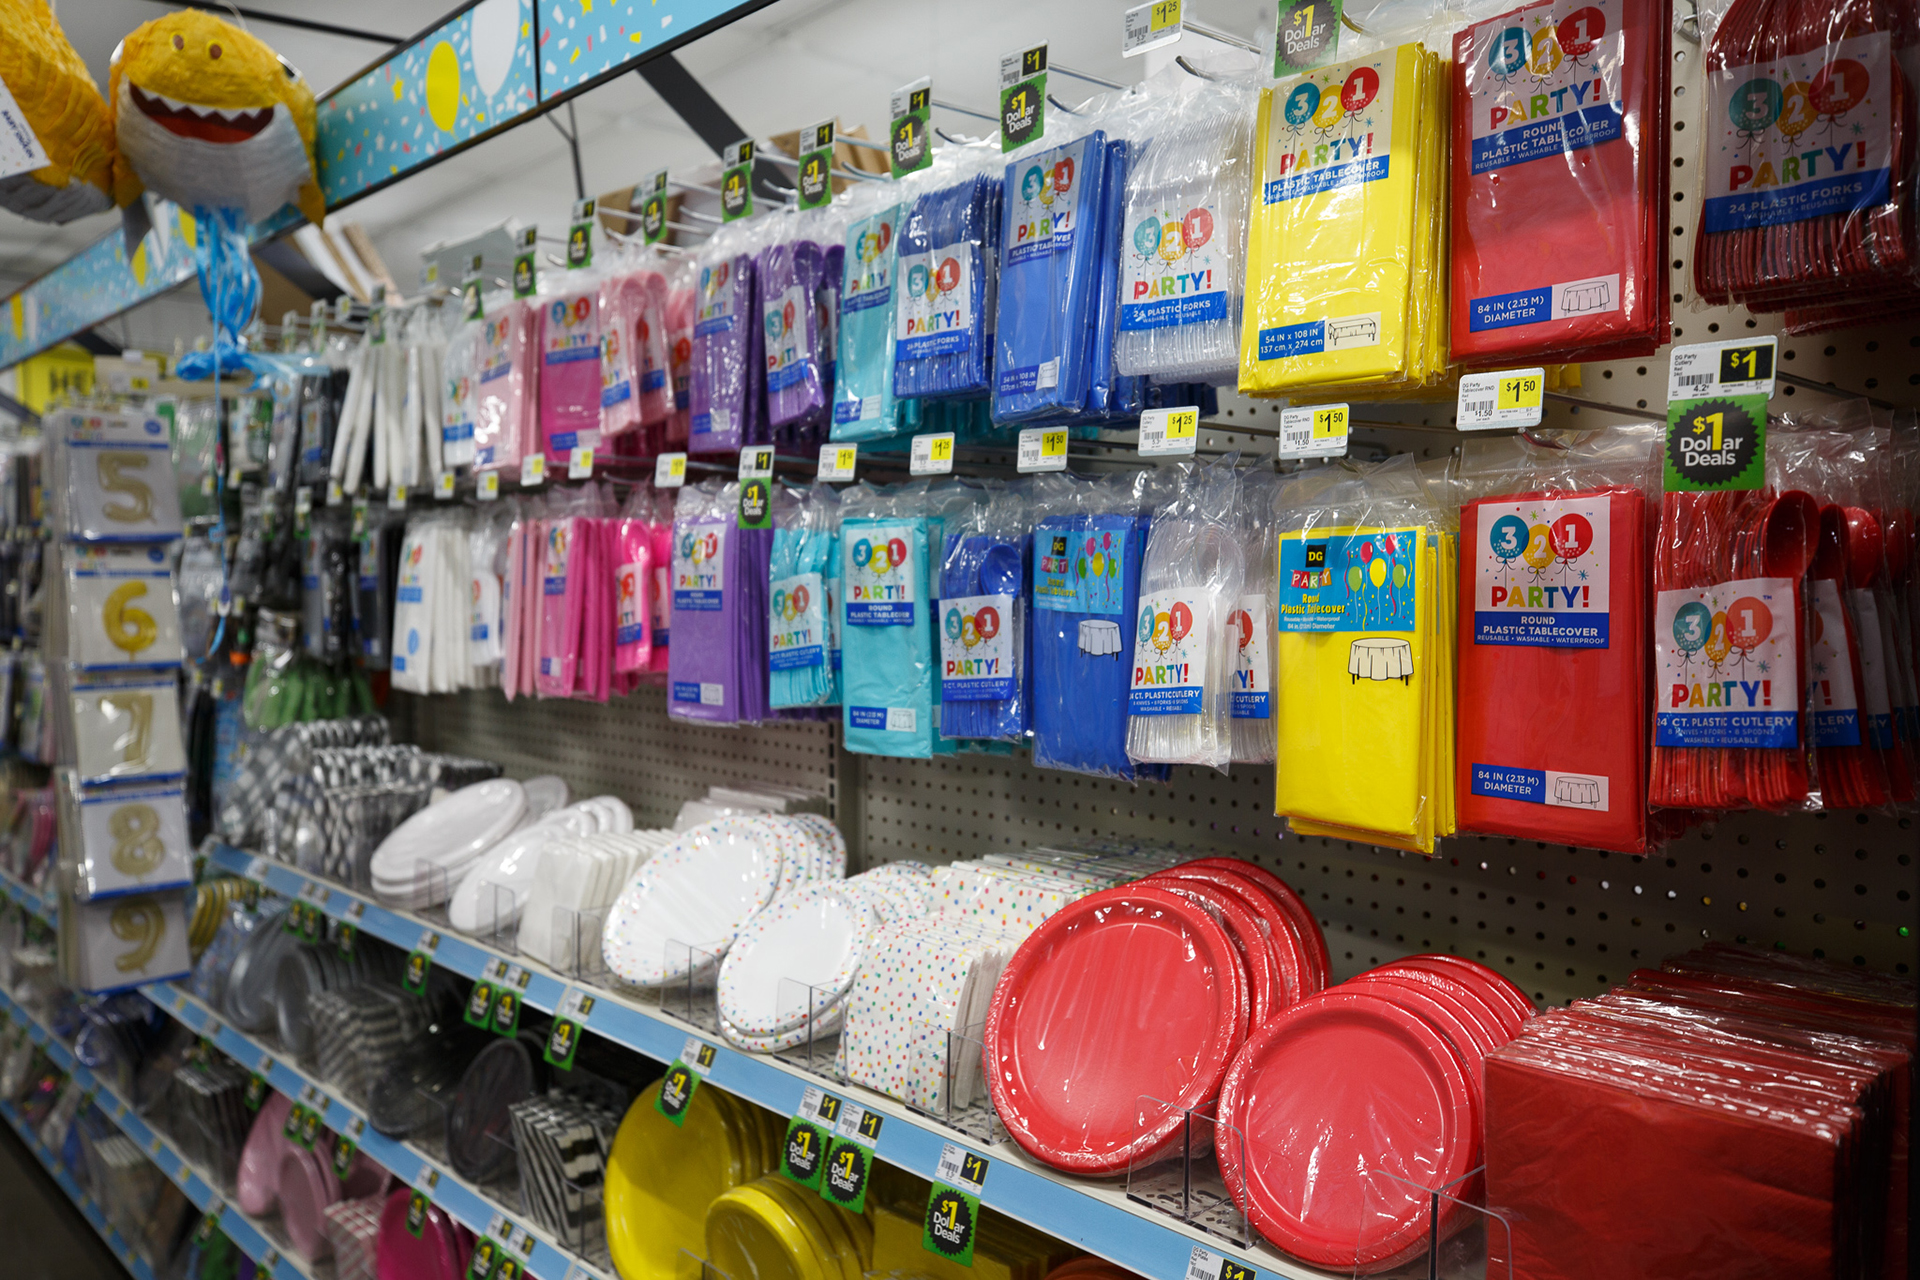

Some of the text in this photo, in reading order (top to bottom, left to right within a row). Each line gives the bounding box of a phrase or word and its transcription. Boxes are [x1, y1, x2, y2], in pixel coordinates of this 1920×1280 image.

[1293, 4, 1315, 38] $1
[1287, 36, 1320, 55] Deals
[1502, 18, 1591, 66] 3 2 1
[1026, 51, 1040, 71] $1
[1011, 90, 1026, 119] $1
[1295, 76, 1366, 119] 3 2 1
[1490, 77, 1602, 131] PARTY!
[1747, 71, 1850, 125] 3 2 1
[900, 122, 913, 149] $1
[1009, 115, 1032, 134] Deals
[1523, 120, 1565, 139] ROUND
[1482, 119, 1609, 161] PLASTIC TABLECOVER
[898, 146, 920, 162] Deals
[1280, 132, 1374, 175] PARTY!
[1475, 154, 1511, 170] REUSABLE
[1518, 145, 1558, 159] WASHABLE
[1272, 176, 1311, 193] PLASTIC
[1313, 160, 1380, 184] TABLECOVER
[1729, 140, 1867, 192] PARTY!
[1026, 173, 1038, 195] 3
[1729, 181, 1864, 215] 24 PLASTIC FORKS
[1742, 196, 1847, 221] WASHABLE REUSABLE
[1144, 216, 1204, 252] 3 2 1
[911, 264, 954, 291] 3 1
[1134, 268, 1212, 300] PARTY!
[1147, 304, 1180, 315] PLASTIC
[1183, 300, 1211, 312] FORKS
[1477, 295, 1544, 315] 84 IN (2.13 M)
[1484, 308, 1536, 324] DIAMETER
[907, 309, 960, 336] PARTY!
[937, 335, 960, 344] FORKS
[1260, 338, 1323, 355] 137 cm 274 cm
[1265, 328, 1319, 344] 54 IN 108 IN
[1684, 353, 1697, 361] Party
[1731, 350, 1757, 379] $1
[1470, 382, 1481, 390] Party
[1692, 412, 1724, 452] $1
[1685, 449, 1736, 468] Deals
[747, 485, 759, 508] $1
[744, 506, 762, 516] Deals
[1053, 541, 1064, 552] DG
[1501, 523, 1579, 559] 3 2 1
[858, 543, 900, 568] 3 2 1
[1308, 550, 1323, 562] DG
[680, 574, 716, 588] PARTY!
[798, 591, 805, 606] 1
[854, 584, 905, 601] PARTY!
[1491, 585, 1590, 609] PARTY!
[103, 580, 157, 656] 6
[868, 604, 893, 612] ROUND
[1281, 603, 1306, 615] Plastic
[950, 613, 994, 640] 3 2 1
[1143, 610, 1183, 642] 3 2 1
[1483, 625, 1598, 637] PLASTIC TABLECOVER
[1520, 616, 1556, 625] ROUND
[1684, 608, 1756, 653] 3 2 1
[773, 629, 811, 649] PARTY!
[1477, 634, 1605, 645] REUSABLE WASHABLE WATERPROOF
[946, 657, 999, 677] PARTY!
[1135, 663, 1189, 687] PARTY!
[957, 680, 1009, 689] PLASTIC CUTLERY
[1145, 690, 1172, 700] PLASTIC
[1671, 679, 1772, 708] PARTY!
[1672, 718, 1690, 728] CT.
[1692, 717, 1728, 728] PLASTIC
[1732, 715, 1795, 727] CUTLERY
[1742, 727, 1776, 736] SPOONS
[1684, 736, 1716, 745] WASHABLE
[1478, 770, 1490, 779] 84
[1492, 772, 1504, 781] IN
[1527, 776, 1540, 787] M)
[1484, 781, 1532, 796] DIAMETER
[108, 803, 165, 879] 8
[110, 901, 165, 974] 9
[823, 1097, 836, 1119] $1
[863, 1113, 877, 1136] $1
[796, 1130, 811, 1159] $1
[790, 1152, 811, 1171] Deals
[839, 1151, 855, 1180] $1
[966, 1156, 982, 1182] $1
[831, 1173, 855, 1193] Deals
[941, 1199, 958, 1231] $1
[934, 1223, 961, 1245] Deals
